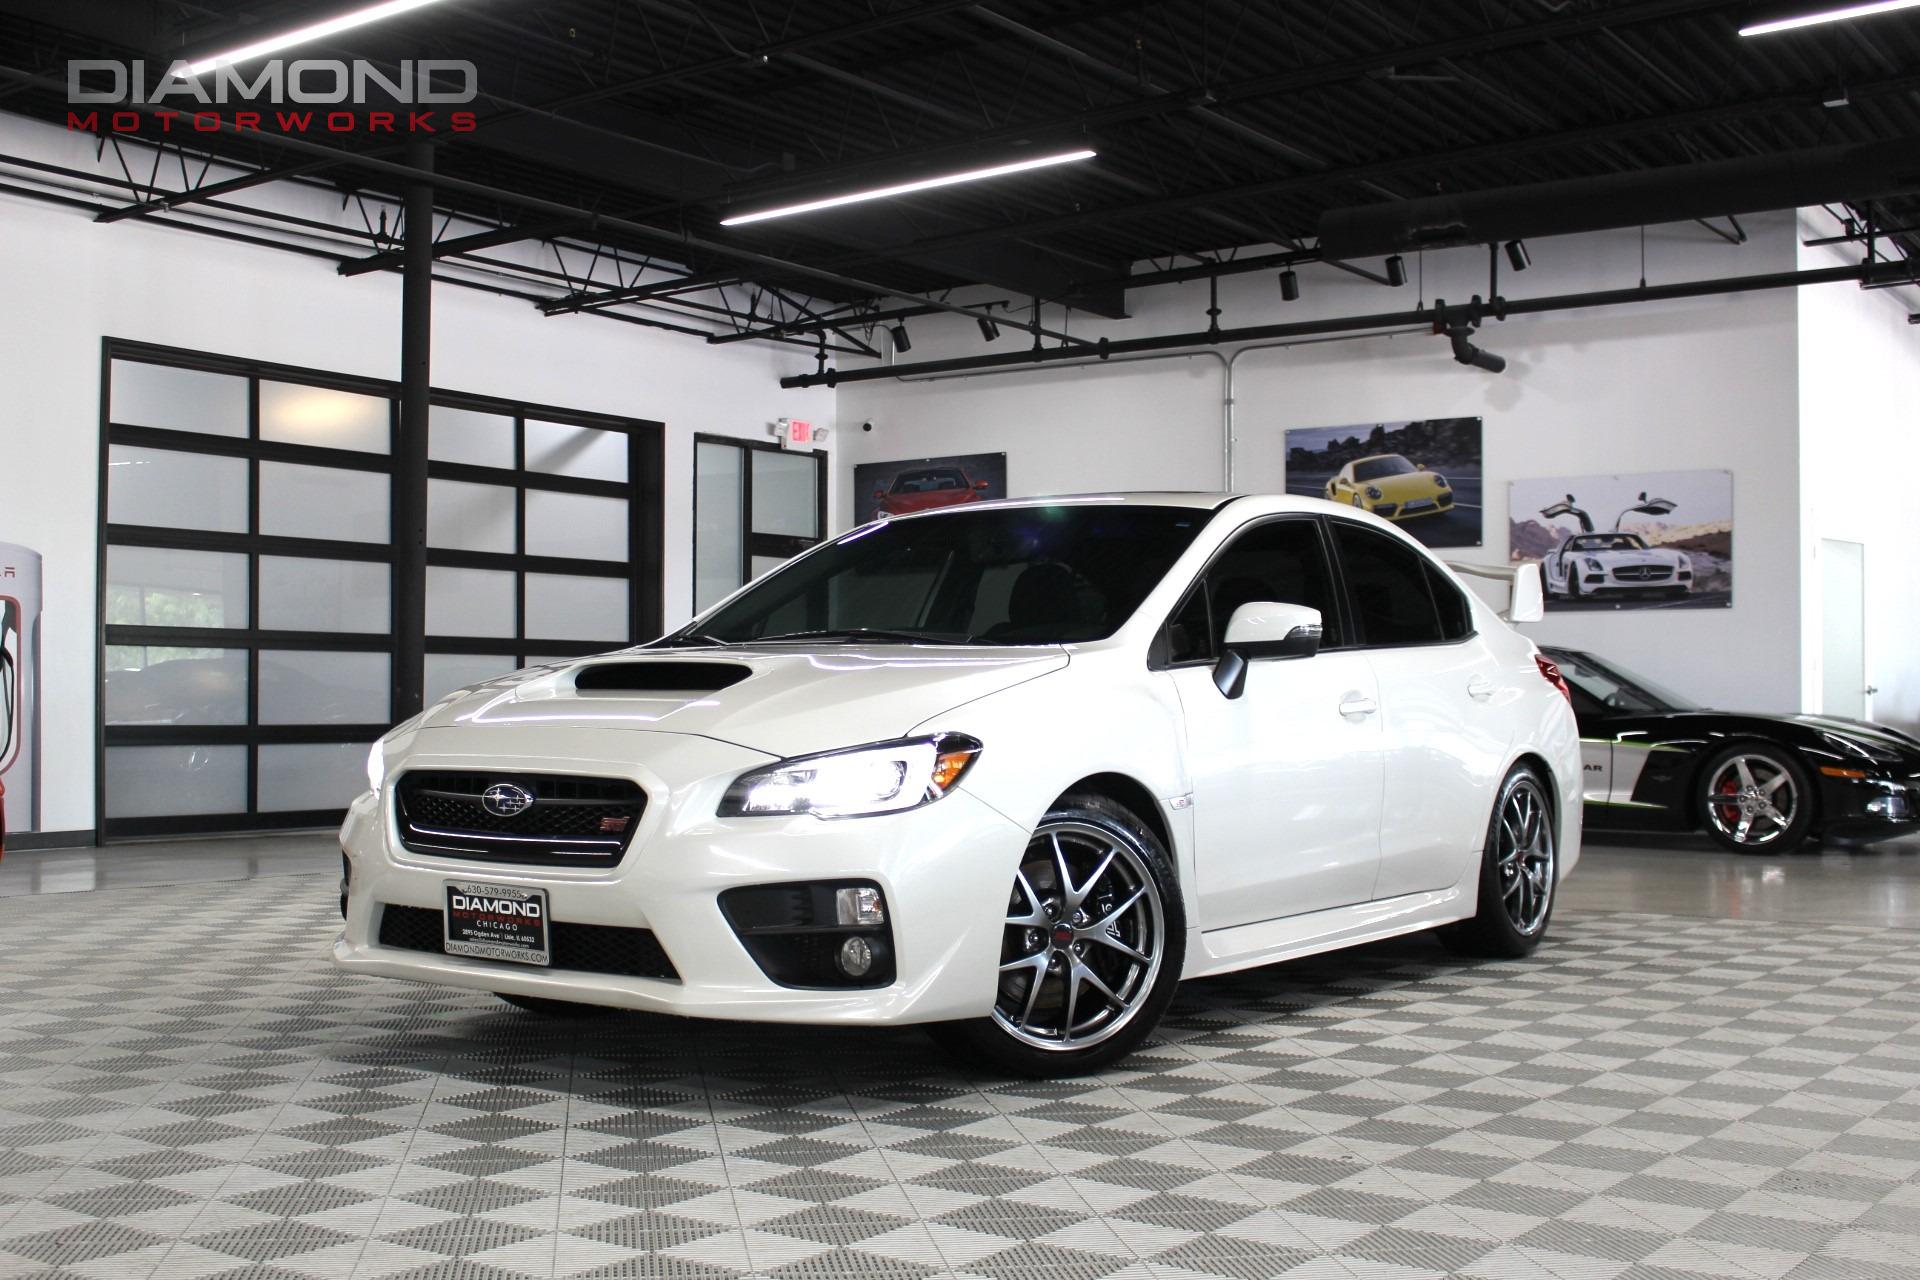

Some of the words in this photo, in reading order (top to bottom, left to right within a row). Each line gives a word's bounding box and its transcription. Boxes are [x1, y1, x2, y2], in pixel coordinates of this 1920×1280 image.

[1583, 764, 1603, 772] AR
[452, 895, 540, 918] DIAMOND
[476, 920, 518, 931] CHICAGO
[445, 942, 549, 963] DIAMONDMOTORWORKS.COM
